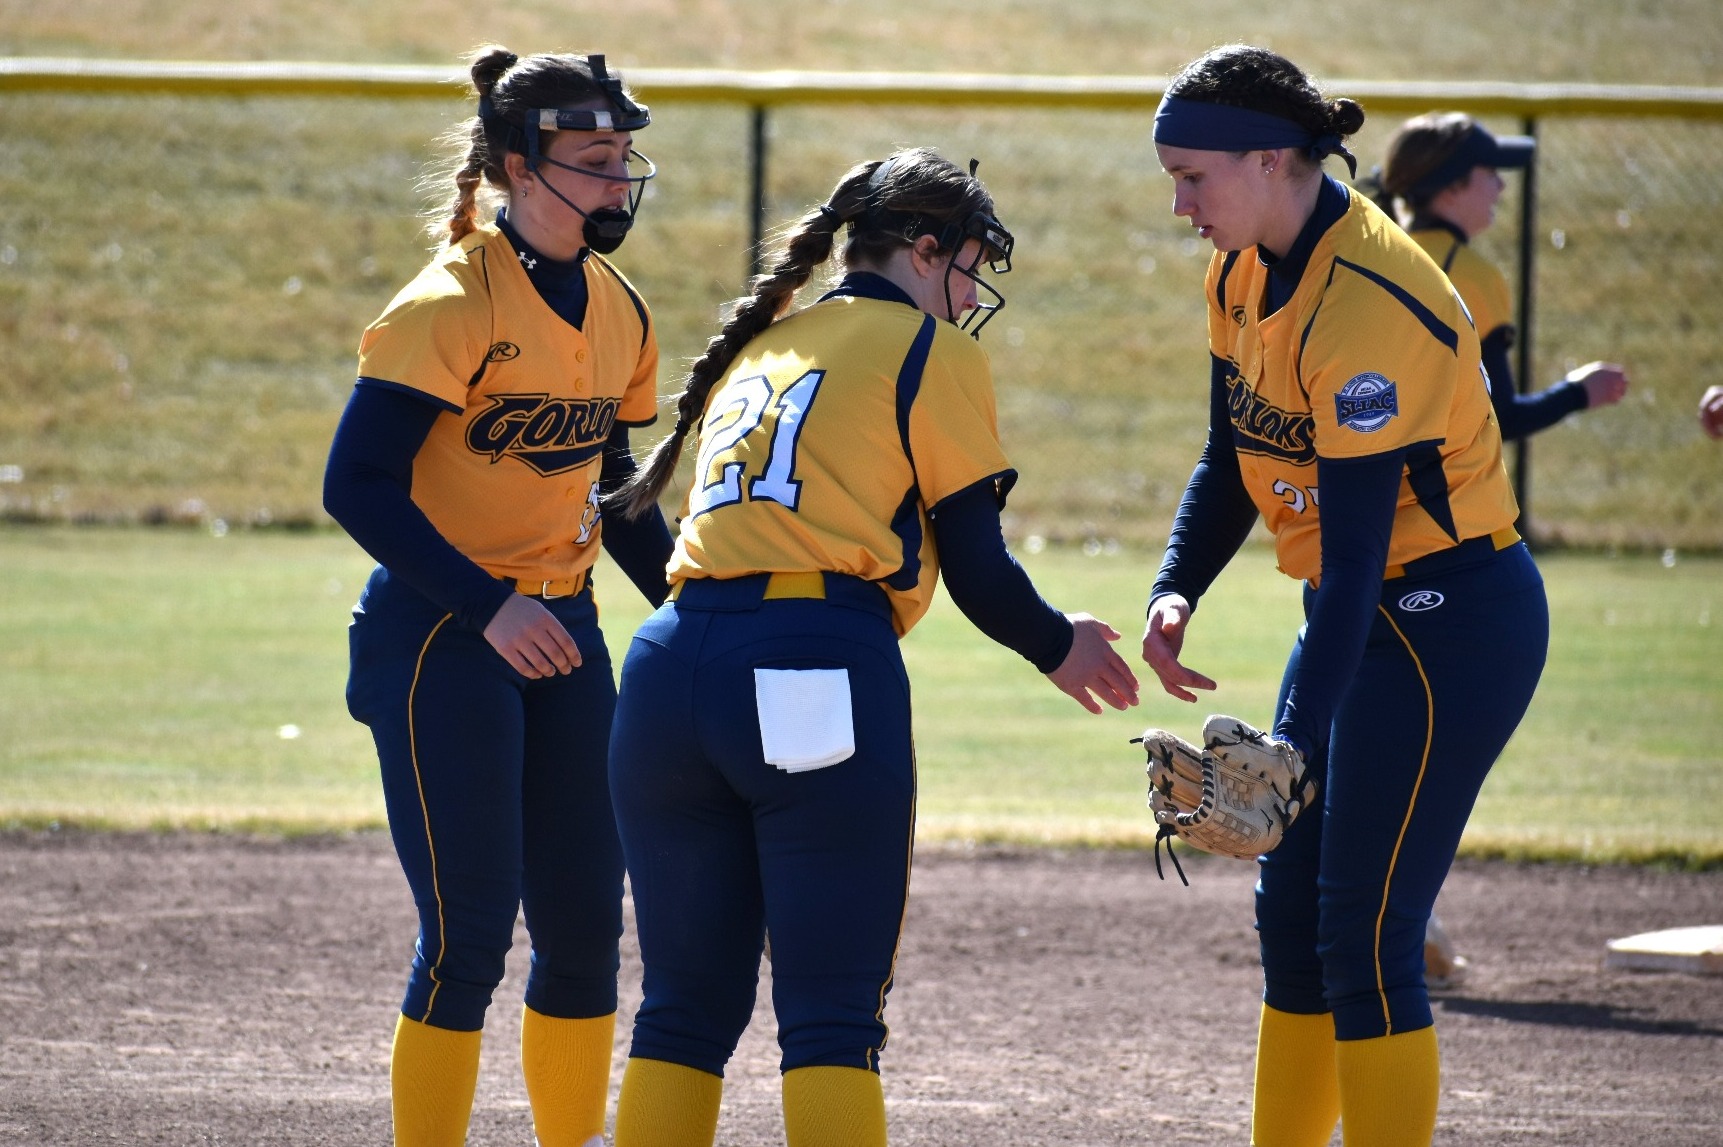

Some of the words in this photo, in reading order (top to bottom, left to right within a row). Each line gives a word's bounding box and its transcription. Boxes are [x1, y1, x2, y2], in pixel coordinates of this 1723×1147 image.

[465, 393, 622, 465] GORLO
[1339, 388, 1395, 421] SLIAC
[690, 369, 827, 523] 21
